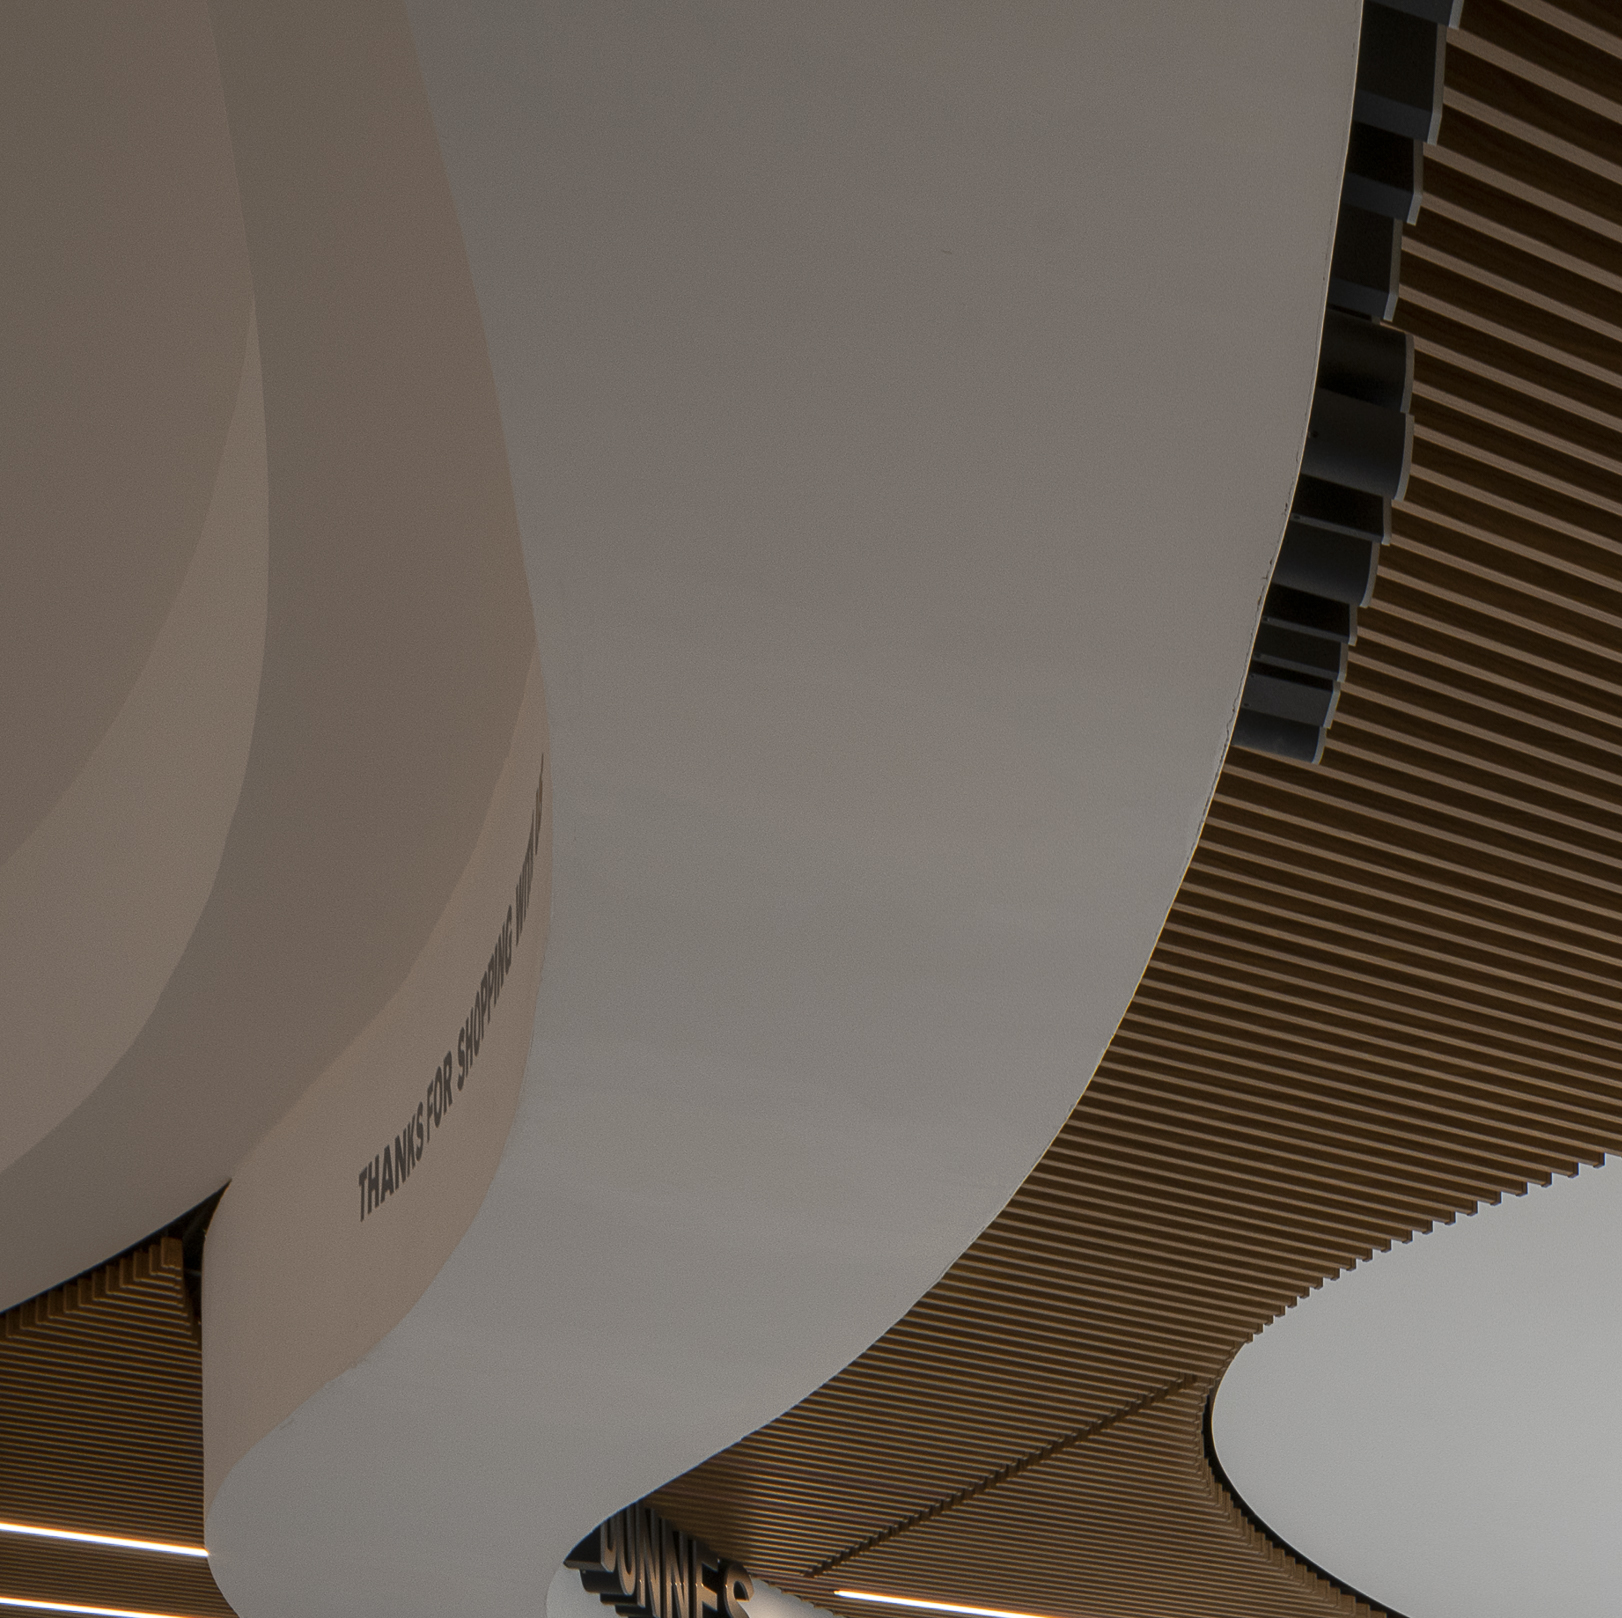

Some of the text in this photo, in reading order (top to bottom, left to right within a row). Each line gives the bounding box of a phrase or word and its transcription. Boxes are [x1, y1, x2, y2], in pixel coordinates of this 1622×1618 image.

[358, 1101, 424, 1223] THANKS
[427, 1050, 453, 1144] FOR
[457, 904, 513, 1092] SHOPPING
